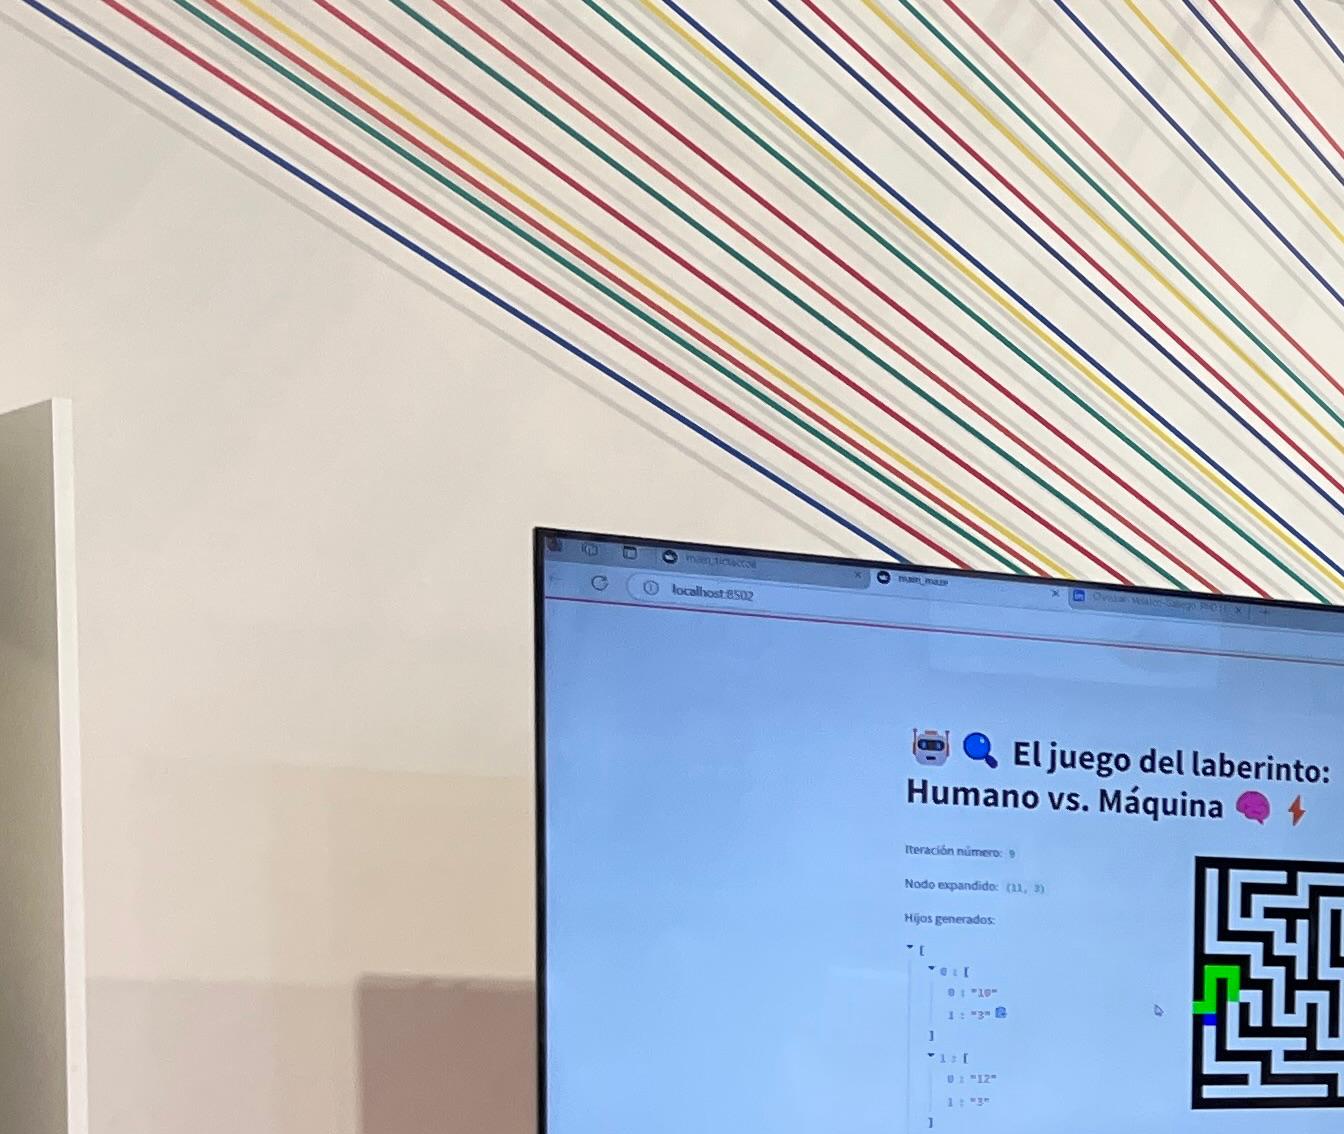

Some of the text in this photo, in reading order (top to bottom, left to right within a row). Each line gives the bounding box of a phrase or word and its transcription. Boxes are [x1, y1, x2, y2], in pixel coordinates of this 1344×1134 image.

[1013, 741, 1330, 784] El juego del laberinto:
[907, 778, 1224, 821] Humano vs. Máquina
[904, 844, 955, 857] Iteración
[956, 845, 1003, 858] número:
[904, 879, 936, 890] Nodo
[937, 880, 999, 892] expandido:
[904, 913, 996, 927] Hijos generados:
